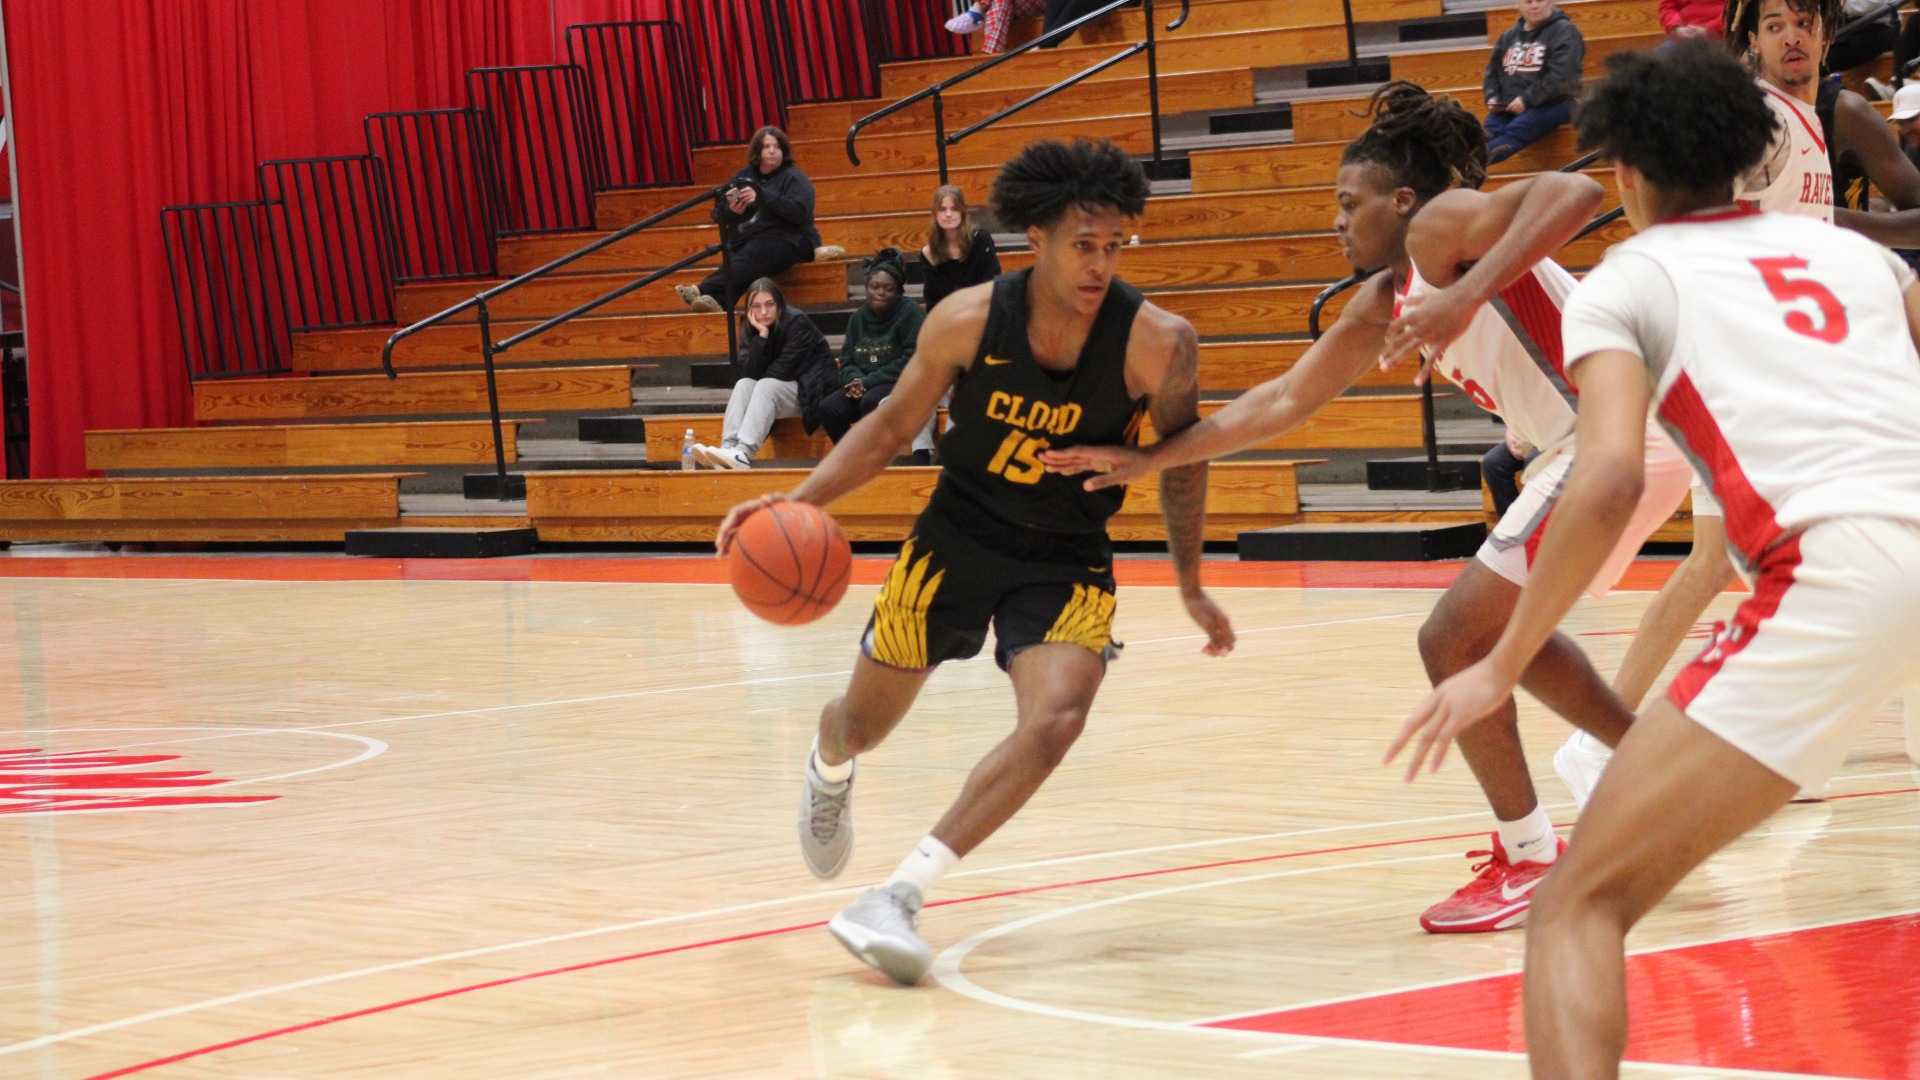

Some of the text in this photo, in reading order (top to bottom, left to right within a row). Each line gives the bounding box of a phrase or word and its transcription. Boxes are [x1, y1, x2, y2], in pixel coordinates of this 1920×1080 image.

[1799, 172, 1833, 206] RAVE
[1746, 253, 1850, 345] 5
[987, 429, 1051, 485] 15
